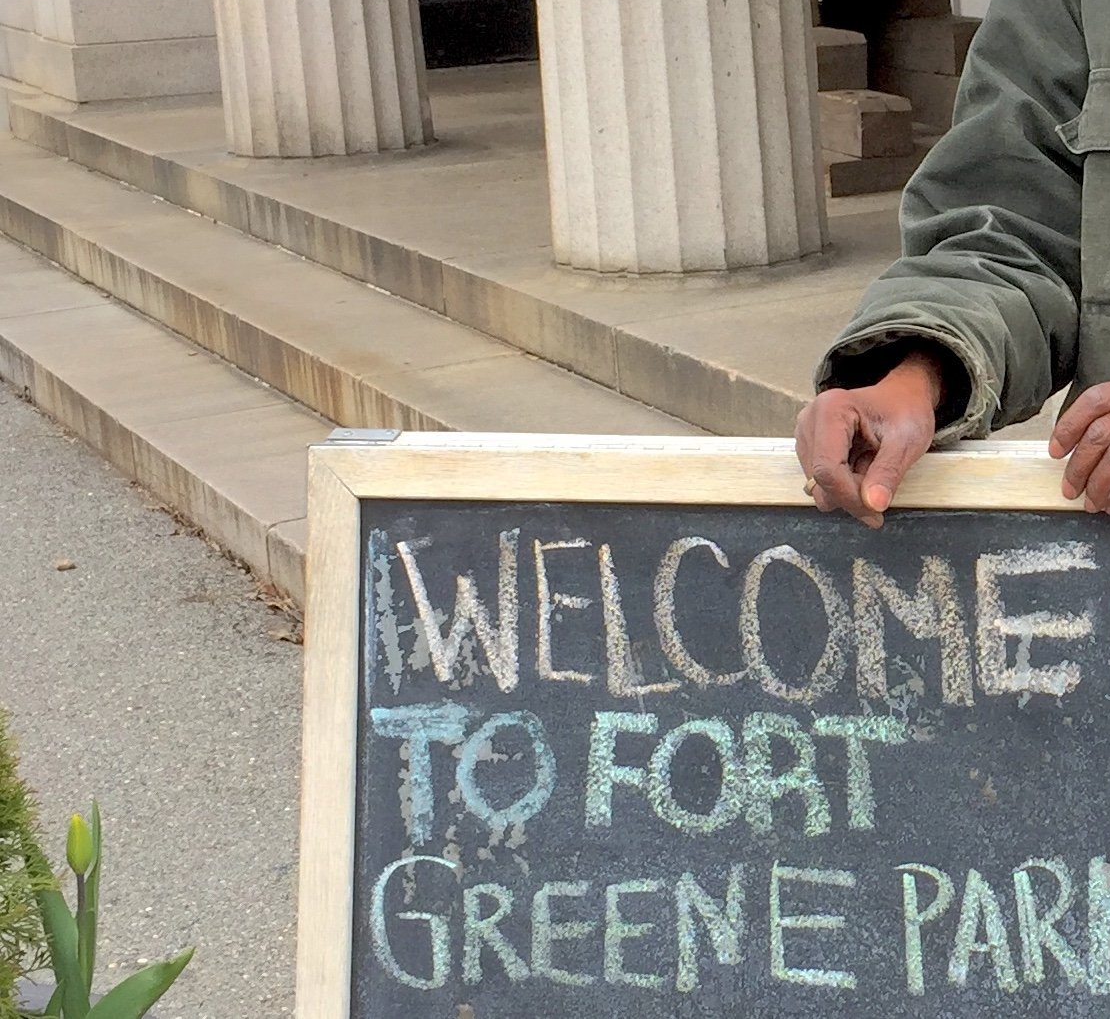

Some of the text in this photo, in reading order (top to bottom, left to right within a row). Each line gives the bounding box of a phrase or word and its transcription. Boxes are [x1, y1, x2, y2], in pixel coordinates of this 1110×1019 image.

[384, 526, 1100, 709] WELCOME
[369, 700, 908, 846] TO FORT
[369, 853, 857, 992] GREENE
